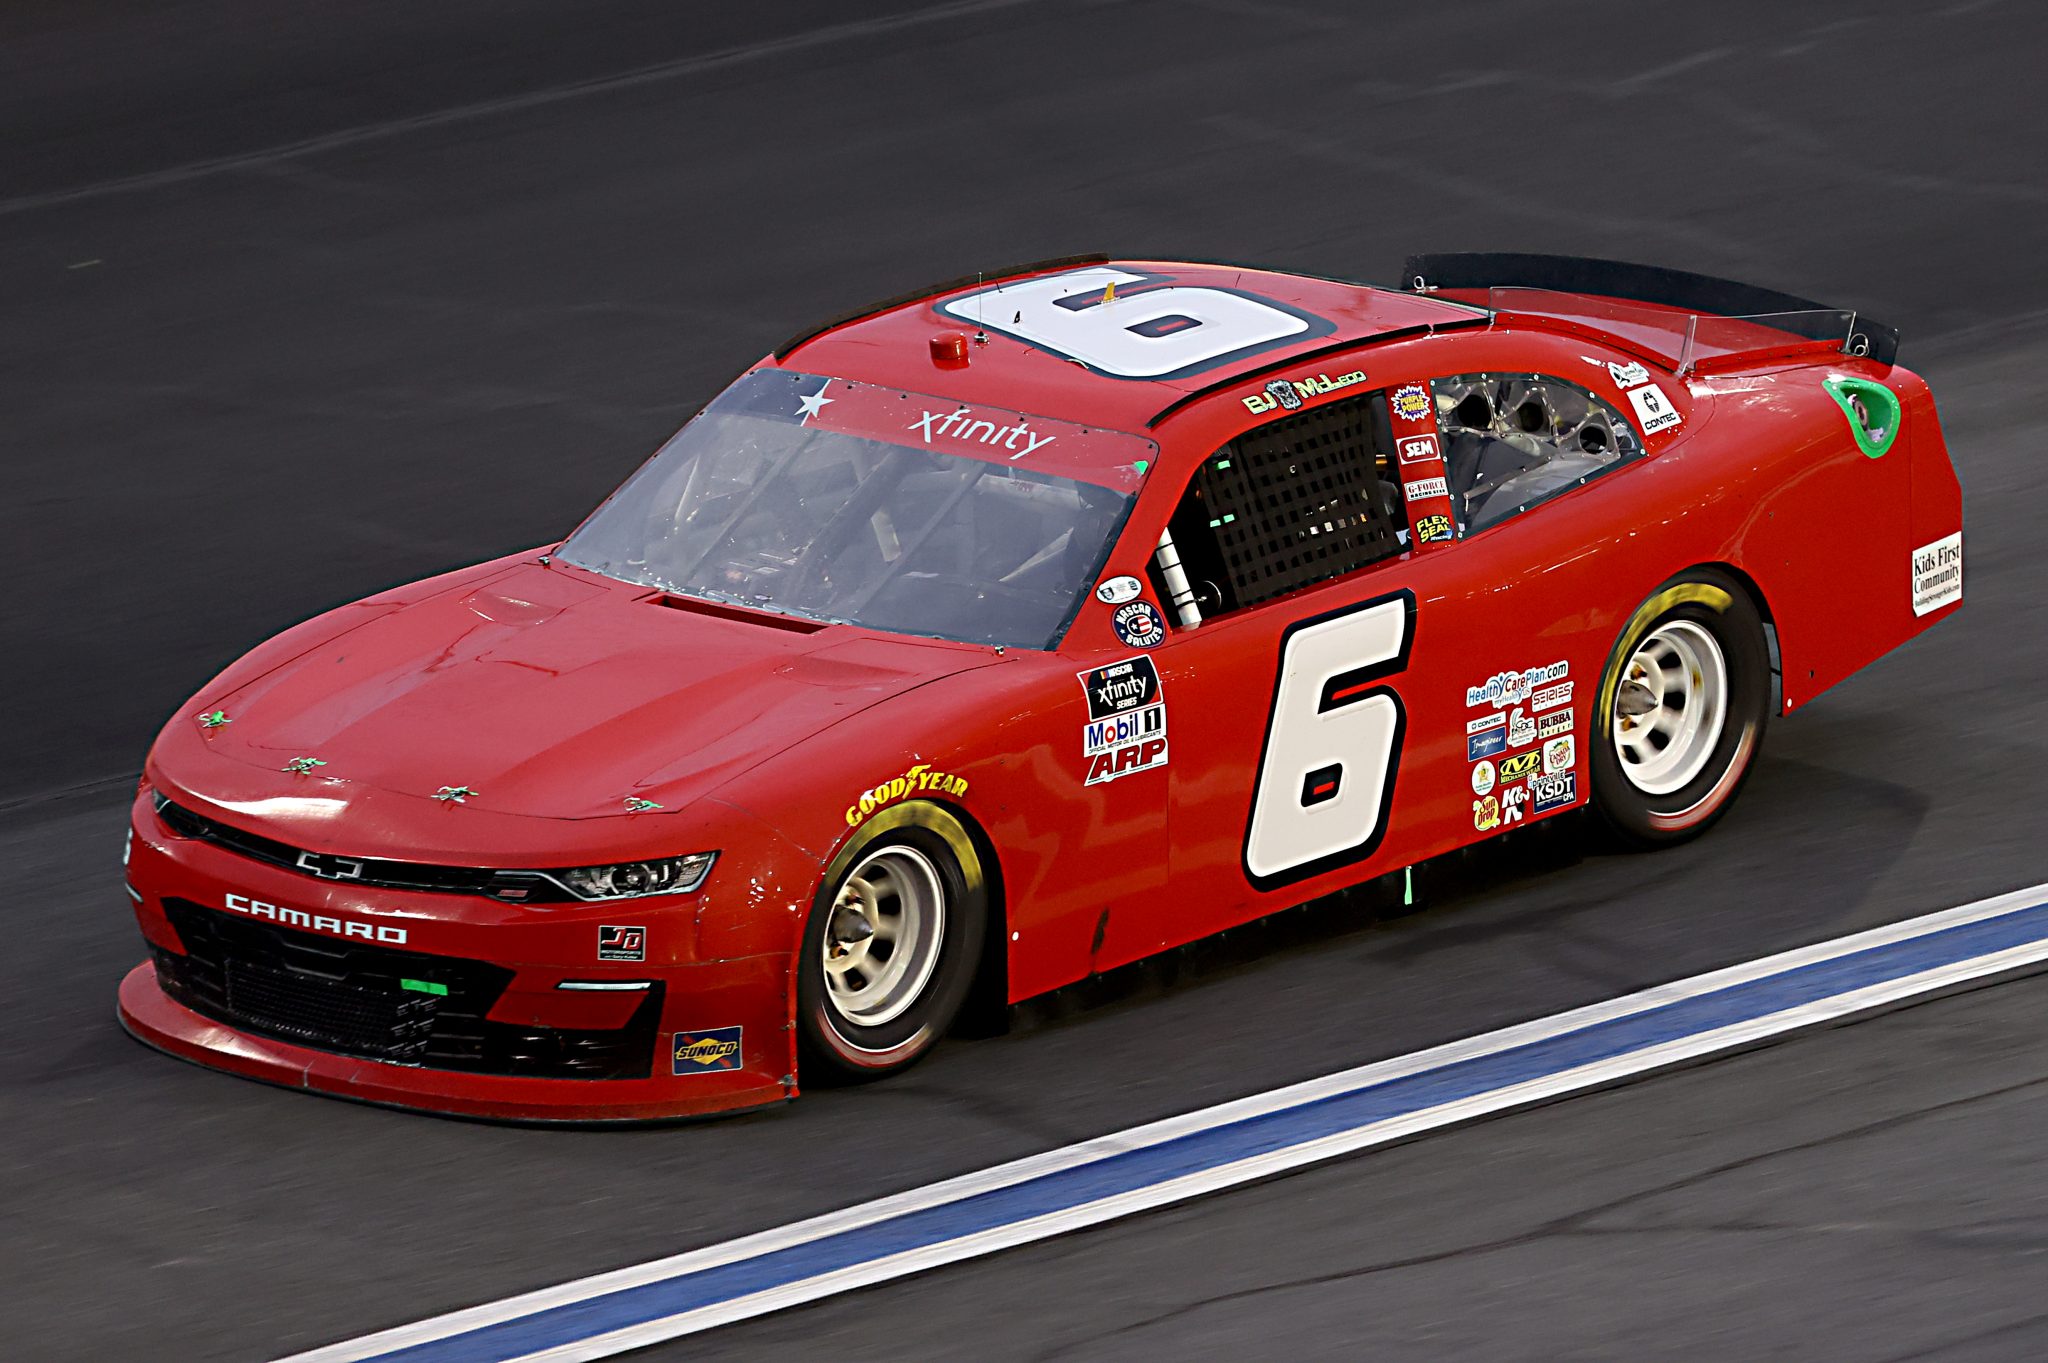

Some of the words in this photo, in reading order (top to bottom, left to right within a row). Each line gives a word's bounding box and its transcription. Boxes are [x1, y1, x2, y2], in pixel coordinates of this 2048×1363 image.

[945, 267, 1312, 377] 6
[1241, 391, 1278, 415] BJ
[1402, 402, 1425, 412] POWER
[1644, 412, 1677, 430] CONTEC
[907, 409, 1057, 460] xfinity
[1405, 439, 1434, 457] SEM
[1408, 480, 1444, 494] G-FORCE
[1410, 490, 1432, 499] RACING
[1416, 515, 1450, 533] FLEX
[1420, 523, 1451, 543] SEAL
[1914, 553, 1936, 577] Kids
[1938, 545, 1960, 567] First
[1914, 564, 1960, 594] Community
[1115, 603, 1153, 625] NASCAR
[1125, 626, 1163, 647] SALUTES
[1100, 663, 1134, 680] NASCAR
[1098, 675, 1147, 706] xfinity
[1468, 663, 1567, 704] HealthyCarePlan.com
[1116, 696, 1138, 710] SERIES
[1088, 713, 1138, 748] Mobil
[1477, 716, 1502, 728] CONTEC
[1540, 711, 1571, 730] BUBBA
[1247, 598, 1405, 877] 6
[1088, 746, 1106, 755] OFFICIAL
[1107, 741, 1123, 749] MOTOR
[1089, 738, 1167, 780] ARP
[1536, 776, 1573, 802] KSDT
[1563, 791, 1575, 802] CPA
[1480, 798, 1496, 812] Sun
[225, 893, 407, 944] CAMARO
[677, 1042, 736, 1059] SUNOCO
